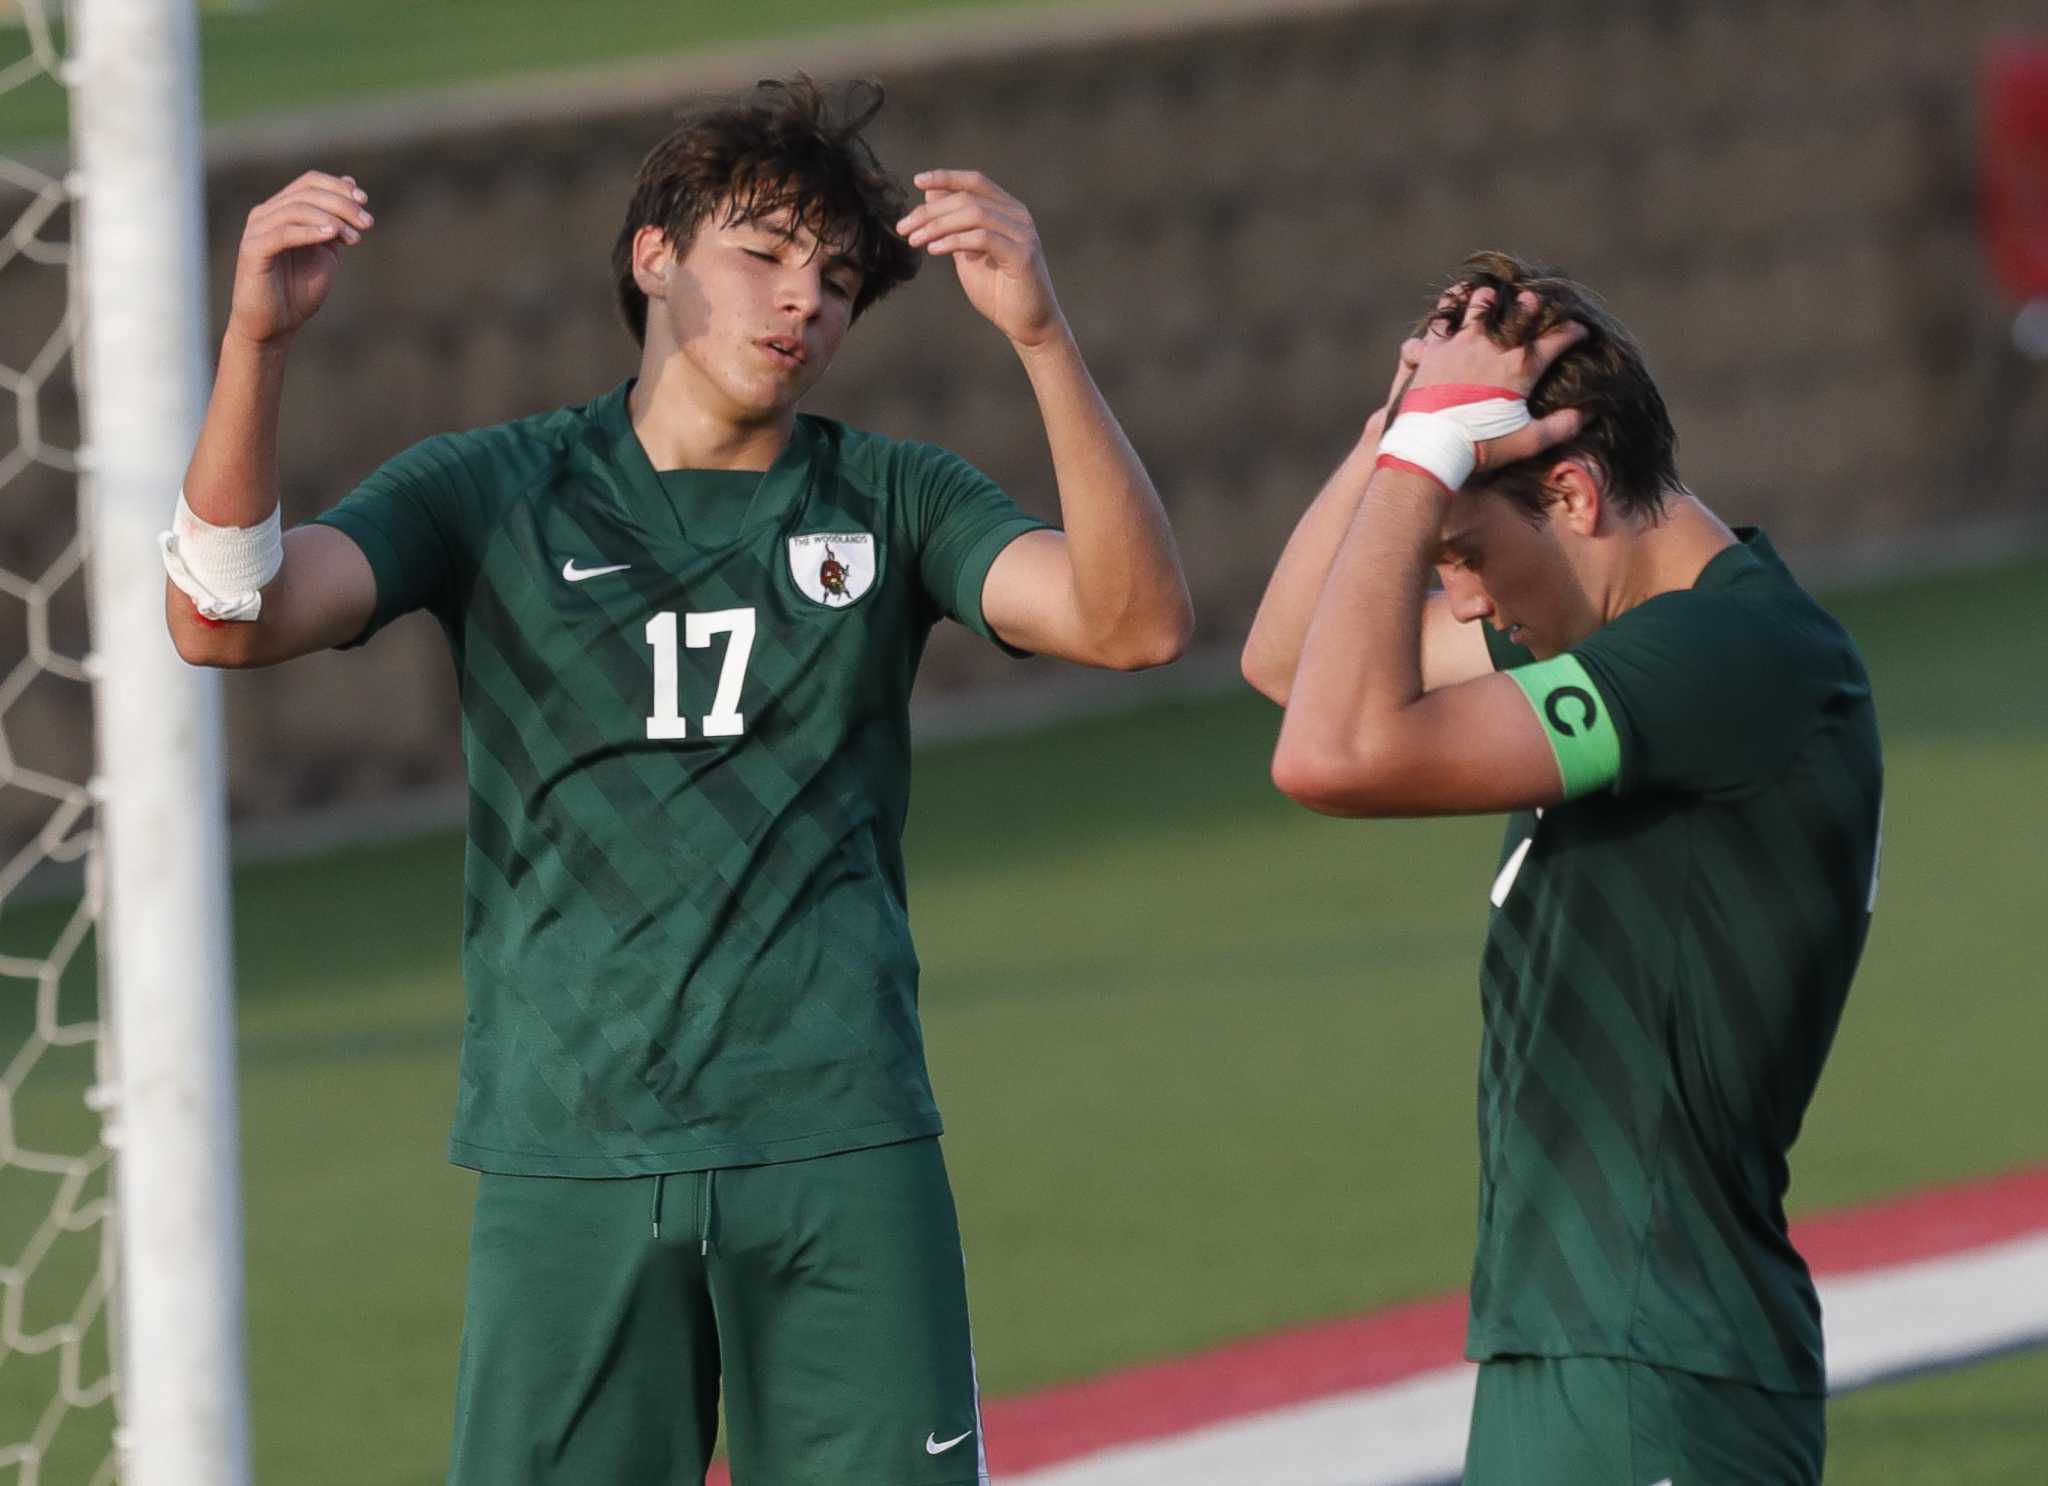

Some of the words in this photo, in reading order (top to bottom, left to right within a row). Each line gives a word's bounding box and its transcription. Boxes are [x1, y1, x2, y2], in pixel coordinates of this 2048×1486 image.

[794, 537, 810, 546] THE
[814, 535, 868, 544] WOODLANDS
[645, 607, 756, 740] 17
[1544, 686, 1597, 738] C
